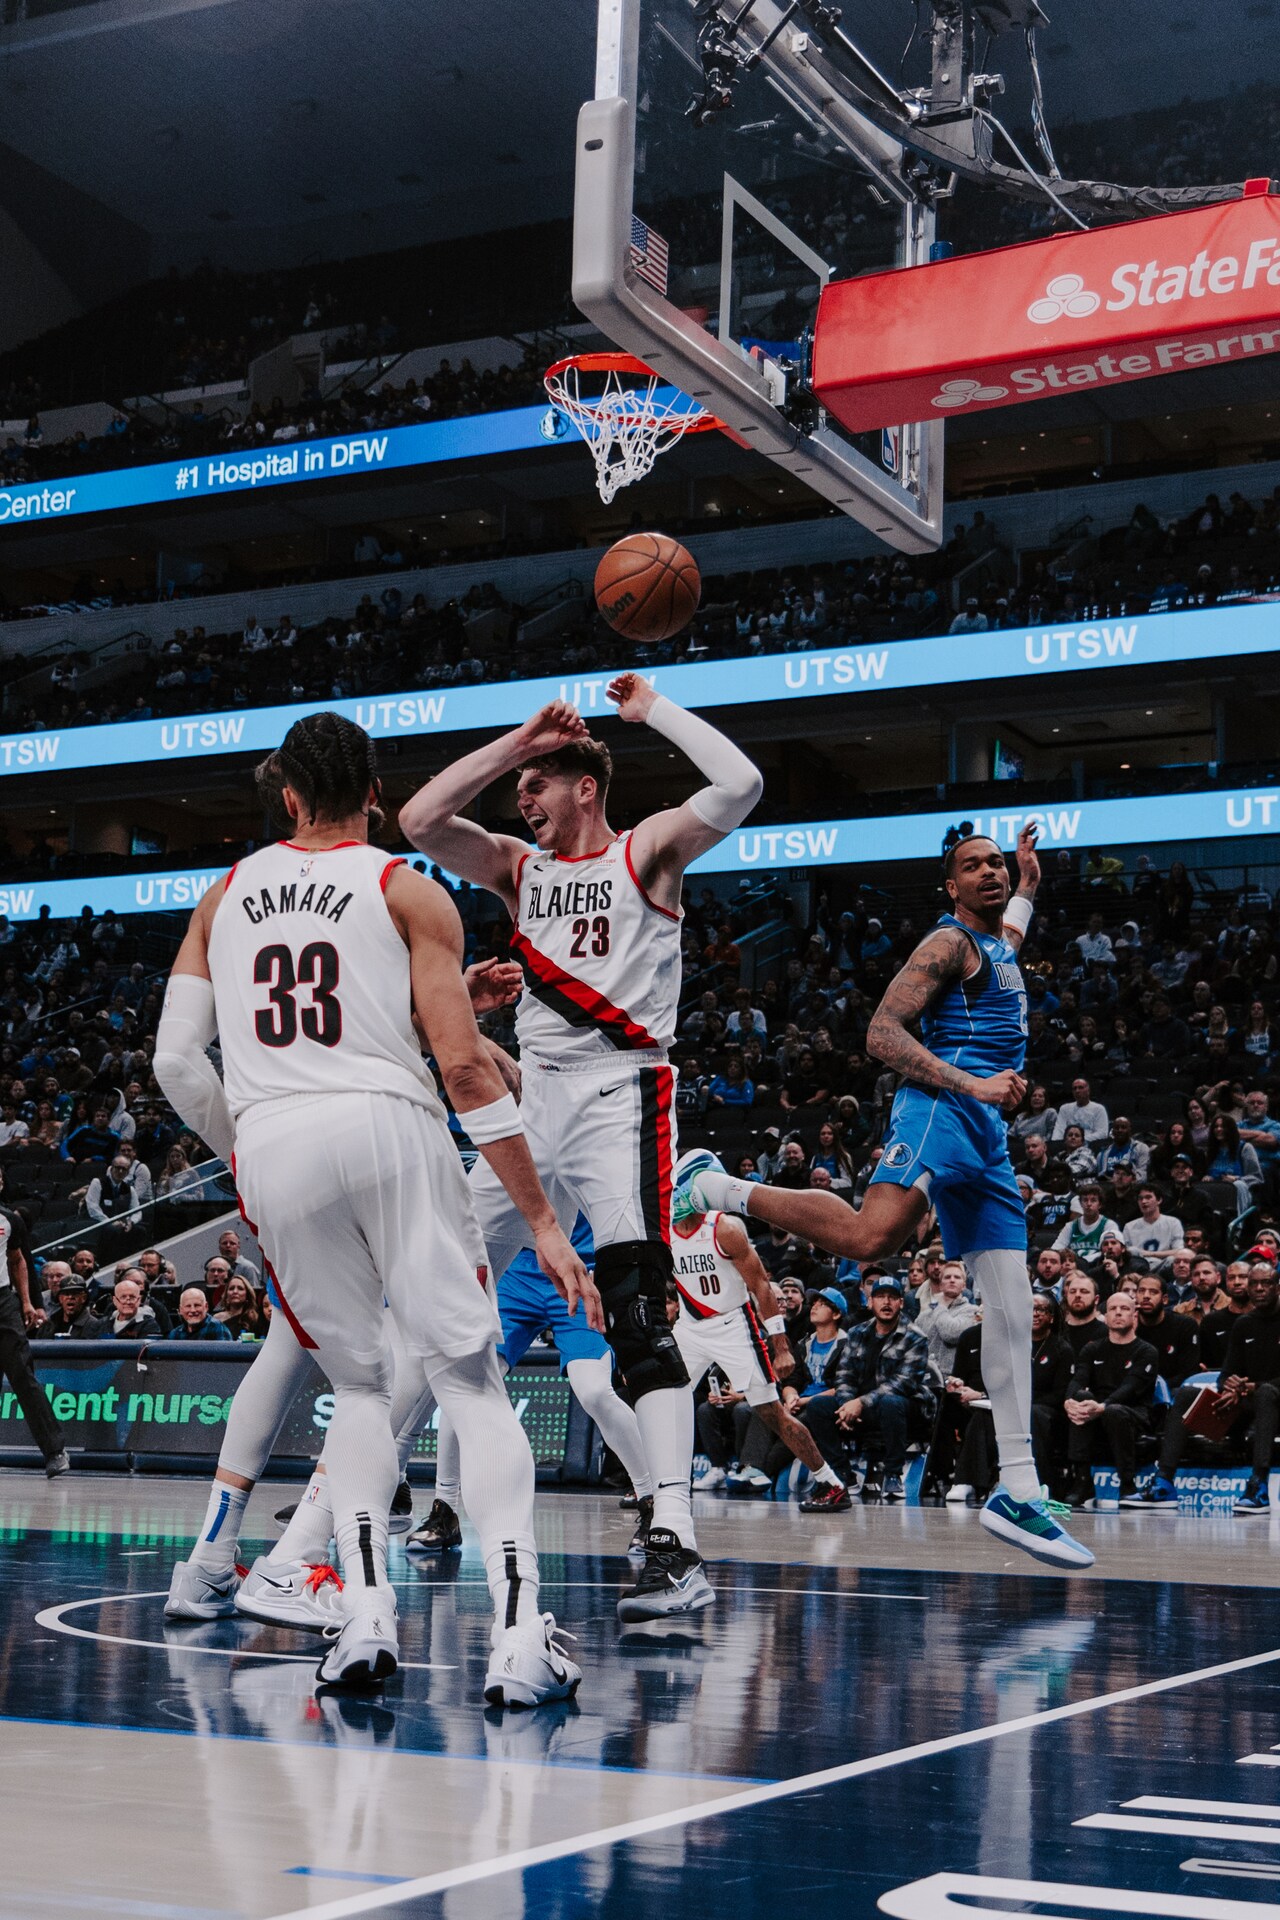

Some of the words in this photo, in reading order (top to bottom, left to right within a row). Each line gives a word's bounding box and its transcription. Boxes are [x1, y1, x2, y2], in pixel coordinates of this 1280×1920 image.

[1106, 250, 1239, 311] State
[1010, 354, 1152, 394] State
[175, 465, 199, 491] #1
[208, 451, 299, 487] Hospital
[304, 448, 324, 472] in
[331, 437, 388, 468] DFW
[0, 488, 76, 519] Center
[1, 737, 59, 767] TSW
[161, 718, 245, 751] UTSW
[356, 697, 446, 731] UTSW
[785, 651, 888, 689] UTSW
[1026, 625, 1138, 665] UTSW
[738, 829, 838, 862] UTSW
[1226, 795, 1278, 828] UT
[242, 883, 354, 925] CAMARA
[528, 880, 613, 920] BLAZERS
[569, 916, 610, 959] 23
[253, 941, 342, 1048] 33
[699, 1274, 720, 1296] 00
